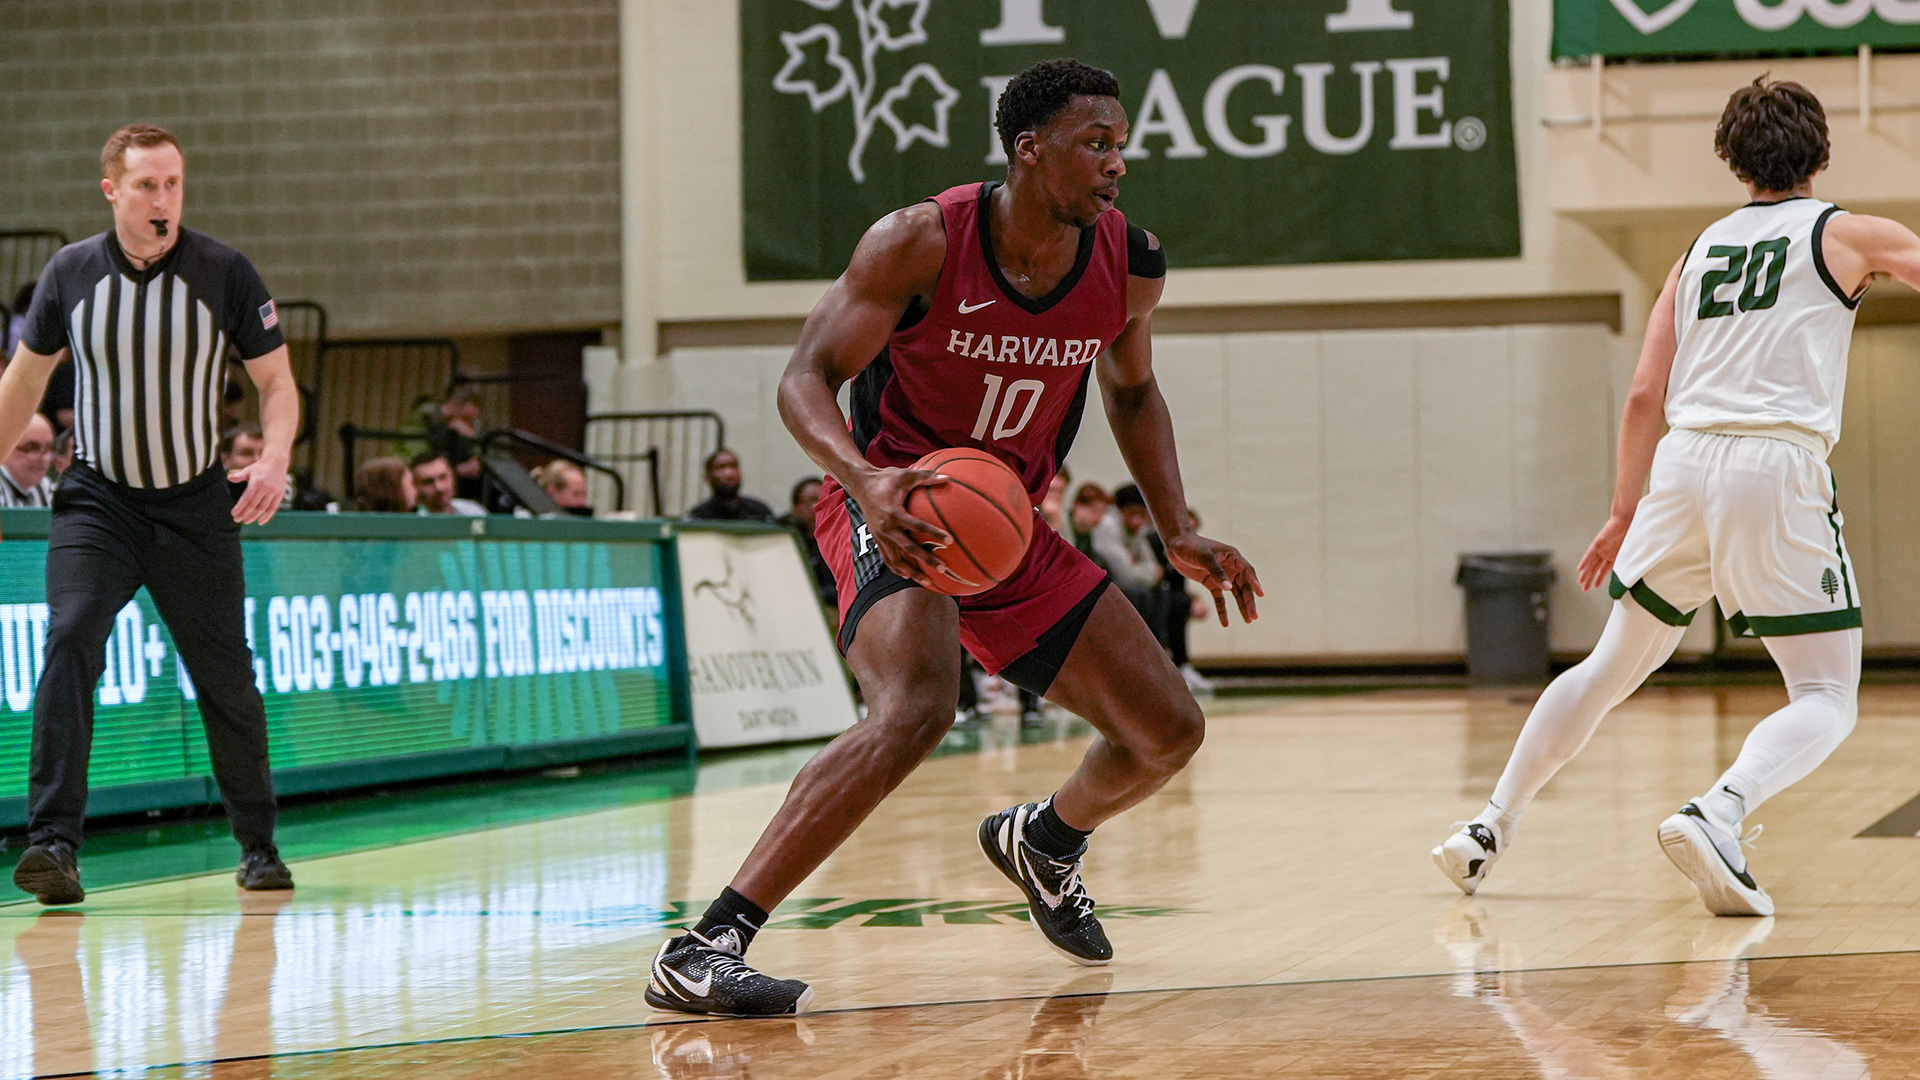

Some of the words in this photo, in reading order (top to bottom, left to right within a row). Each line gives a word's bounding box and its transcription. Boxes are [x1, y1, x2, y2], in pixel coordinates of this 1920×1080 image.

[980, 57, 1453, 165] AGUE
[1697, 236, 1791, 320] 20
[946, 329, 1102, 367] HARVARD
[970, 373, 1045, 441] 10
[268, 590, 479, 694] 603-646-2466
[481, 589, 535, 678] FOR
[533, 586, 664, 675] DISCOUNTS
